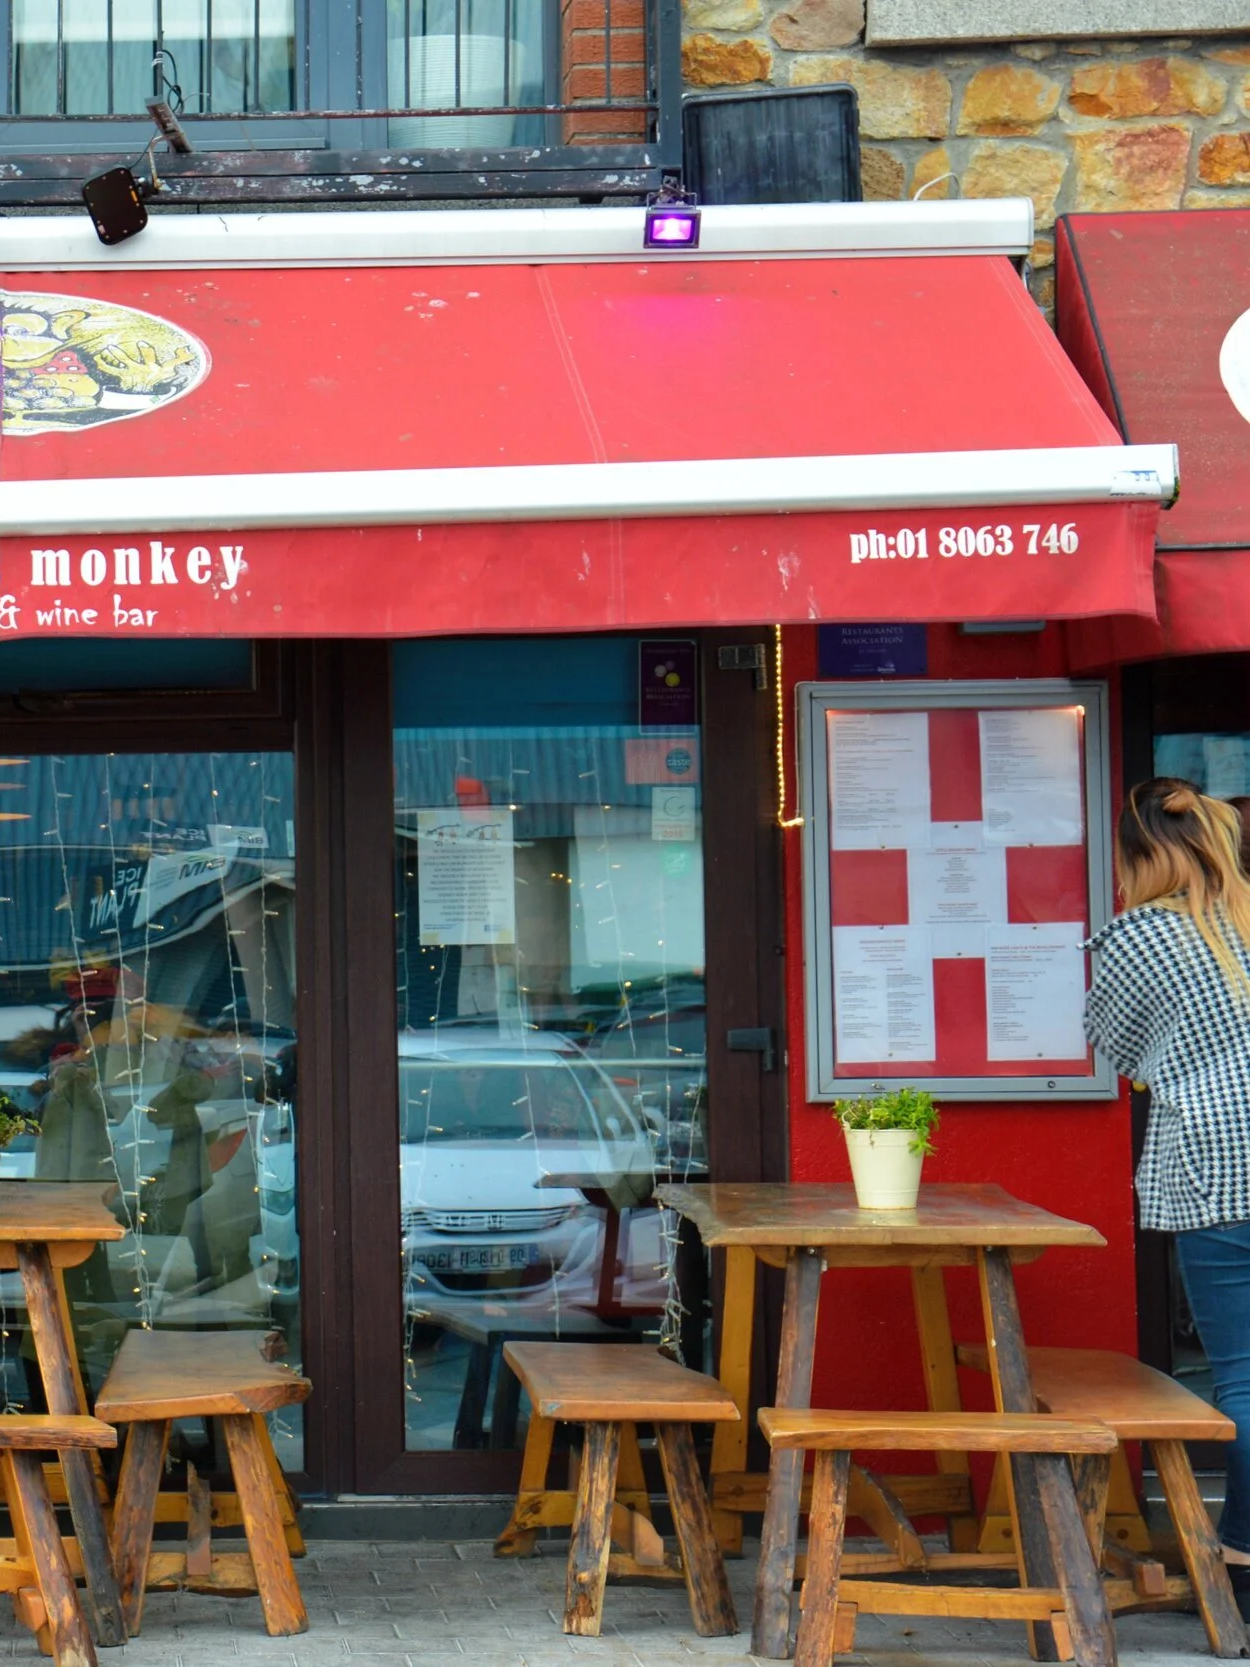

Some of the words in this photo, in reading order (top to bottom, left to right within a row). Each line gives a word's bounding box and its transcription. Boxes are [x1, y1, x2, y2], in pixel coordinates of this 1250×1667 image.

[850, 528, 929, 564] ph:01
[938, 524, 1014, 558] 8063
[1022, 523, 1080, 555] 746
[30, 541, 244, 590] monkey
[36, 600, 99, 627] wine
[113, 594, 158, 627] bar
